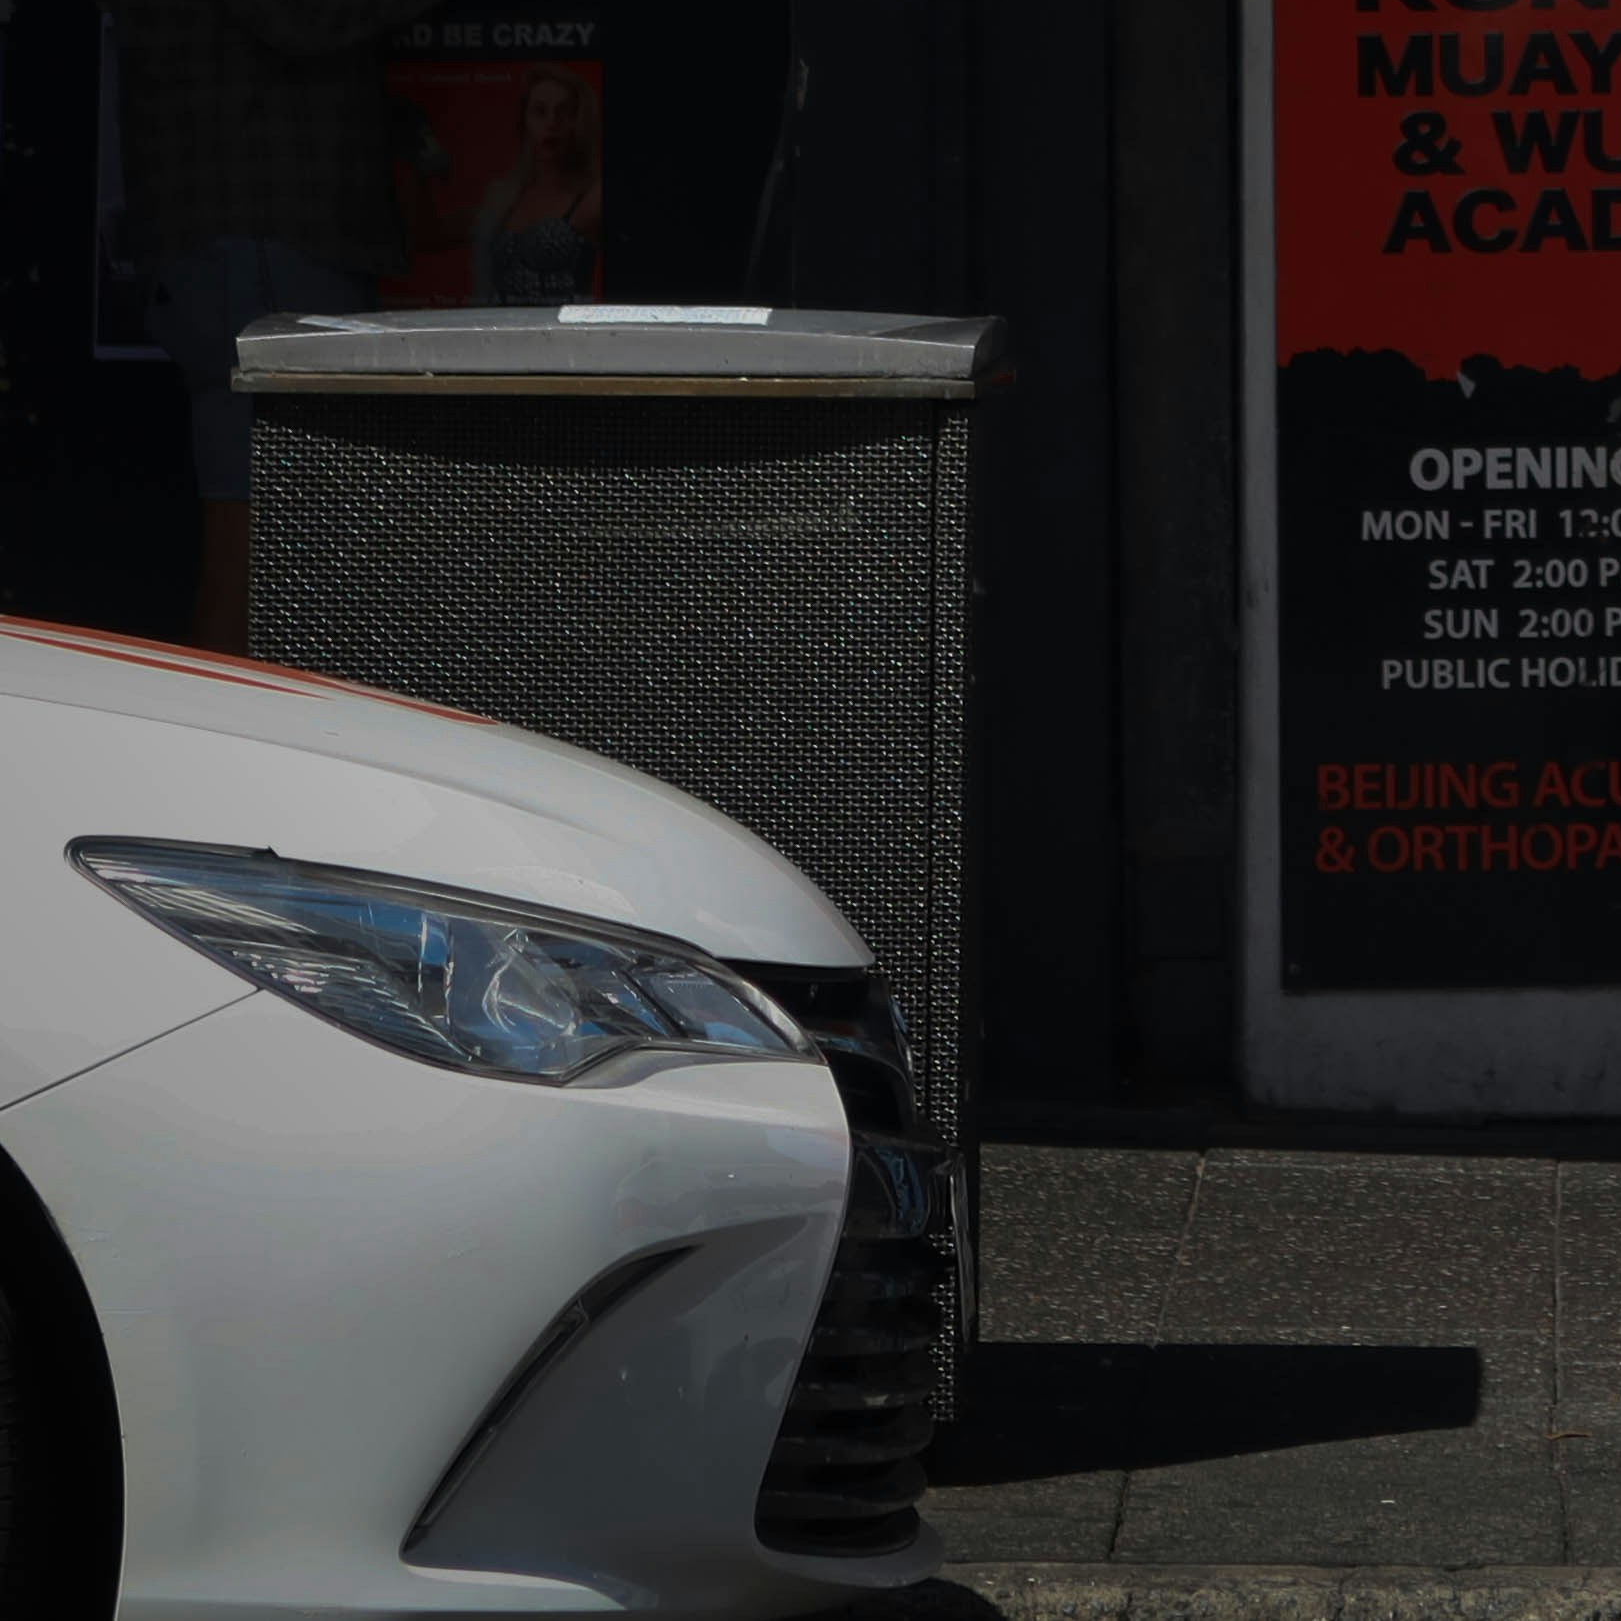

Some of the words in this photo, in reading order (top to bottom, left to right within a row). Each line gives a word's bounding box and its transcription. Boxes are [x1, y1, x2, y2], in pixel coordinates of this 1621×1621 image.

[441, 22, 484, 49] BE
[492, 20, 597, 49] CRAZY
[1392, 109, 1467, 177] &
[1360, 510, 1451, 542] MON
[1482, 508, 1538, 540] FRI
[1427, 558, 1496, 590] SAT
[1512, 557, 1589, 589] 2:00
[1423, 607, 1500, 640] SUN
[1518, 607, 1596, 639] 2:00
[1381, 657, 1512, 690] PUBLIC
[1315, 760, 1522, 810] BEIJING
[1313, 825, 1356, 874] &
